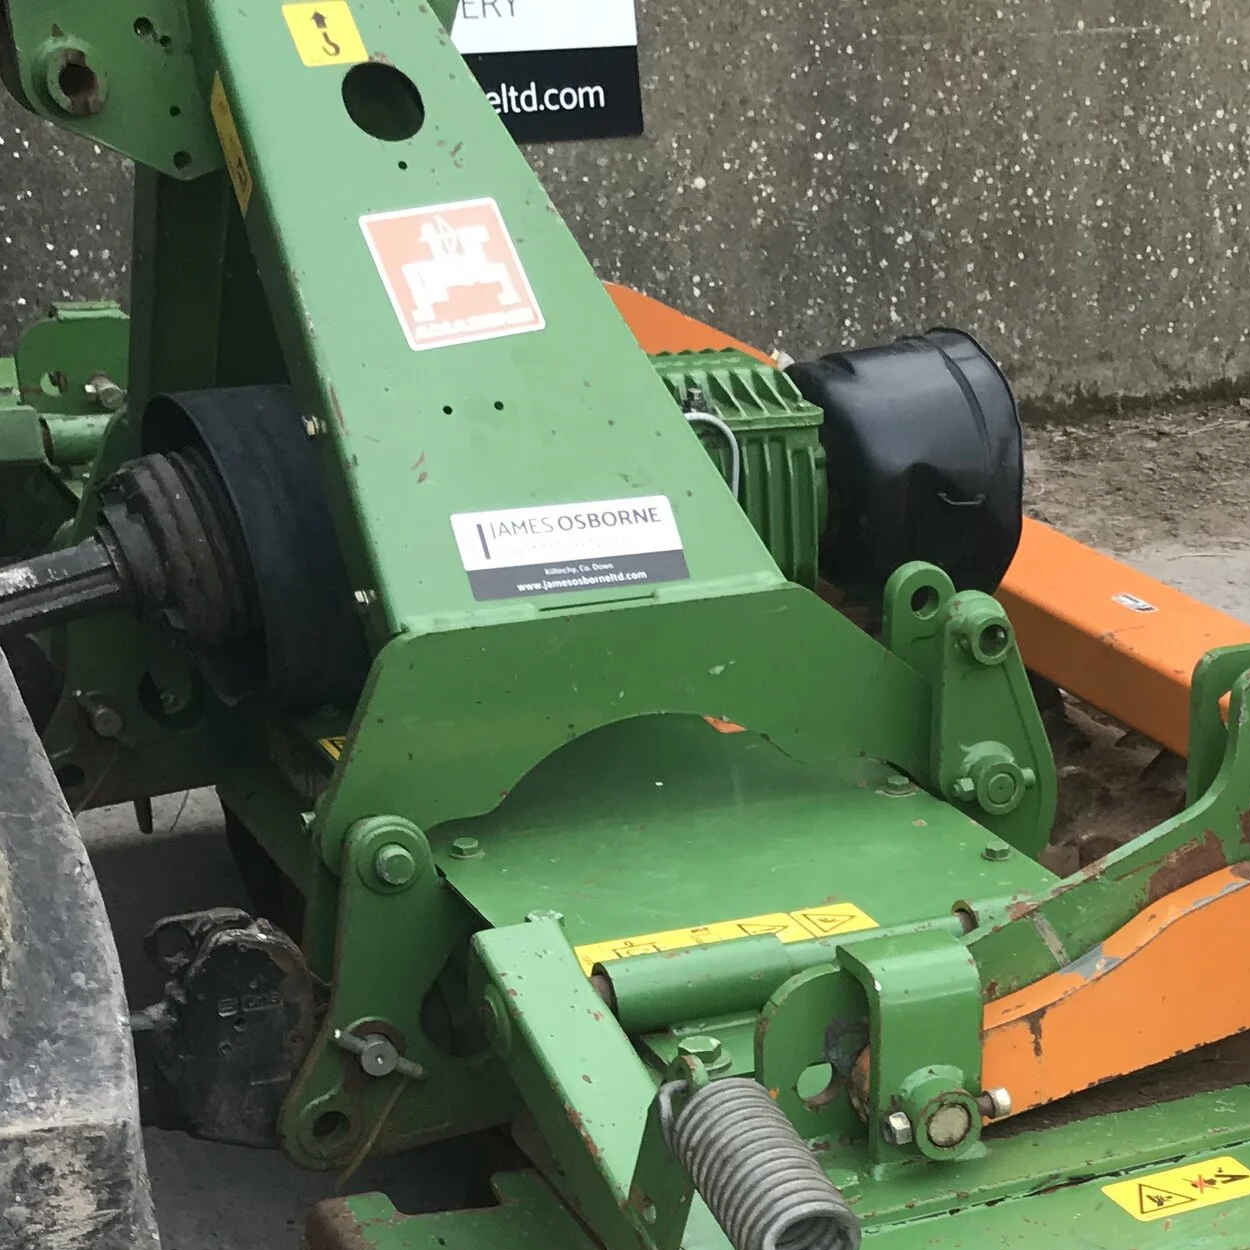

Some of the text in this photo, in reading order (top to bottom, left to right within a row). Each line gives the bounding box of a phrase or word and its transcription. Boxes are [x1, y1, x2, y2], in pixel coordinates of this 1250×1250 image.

[490, 507, 662, 540] JAMES OSBORNE
[591, 562, 614, 571] Down
[516, 570, 648, 592] www.jamesosborneltd.com
